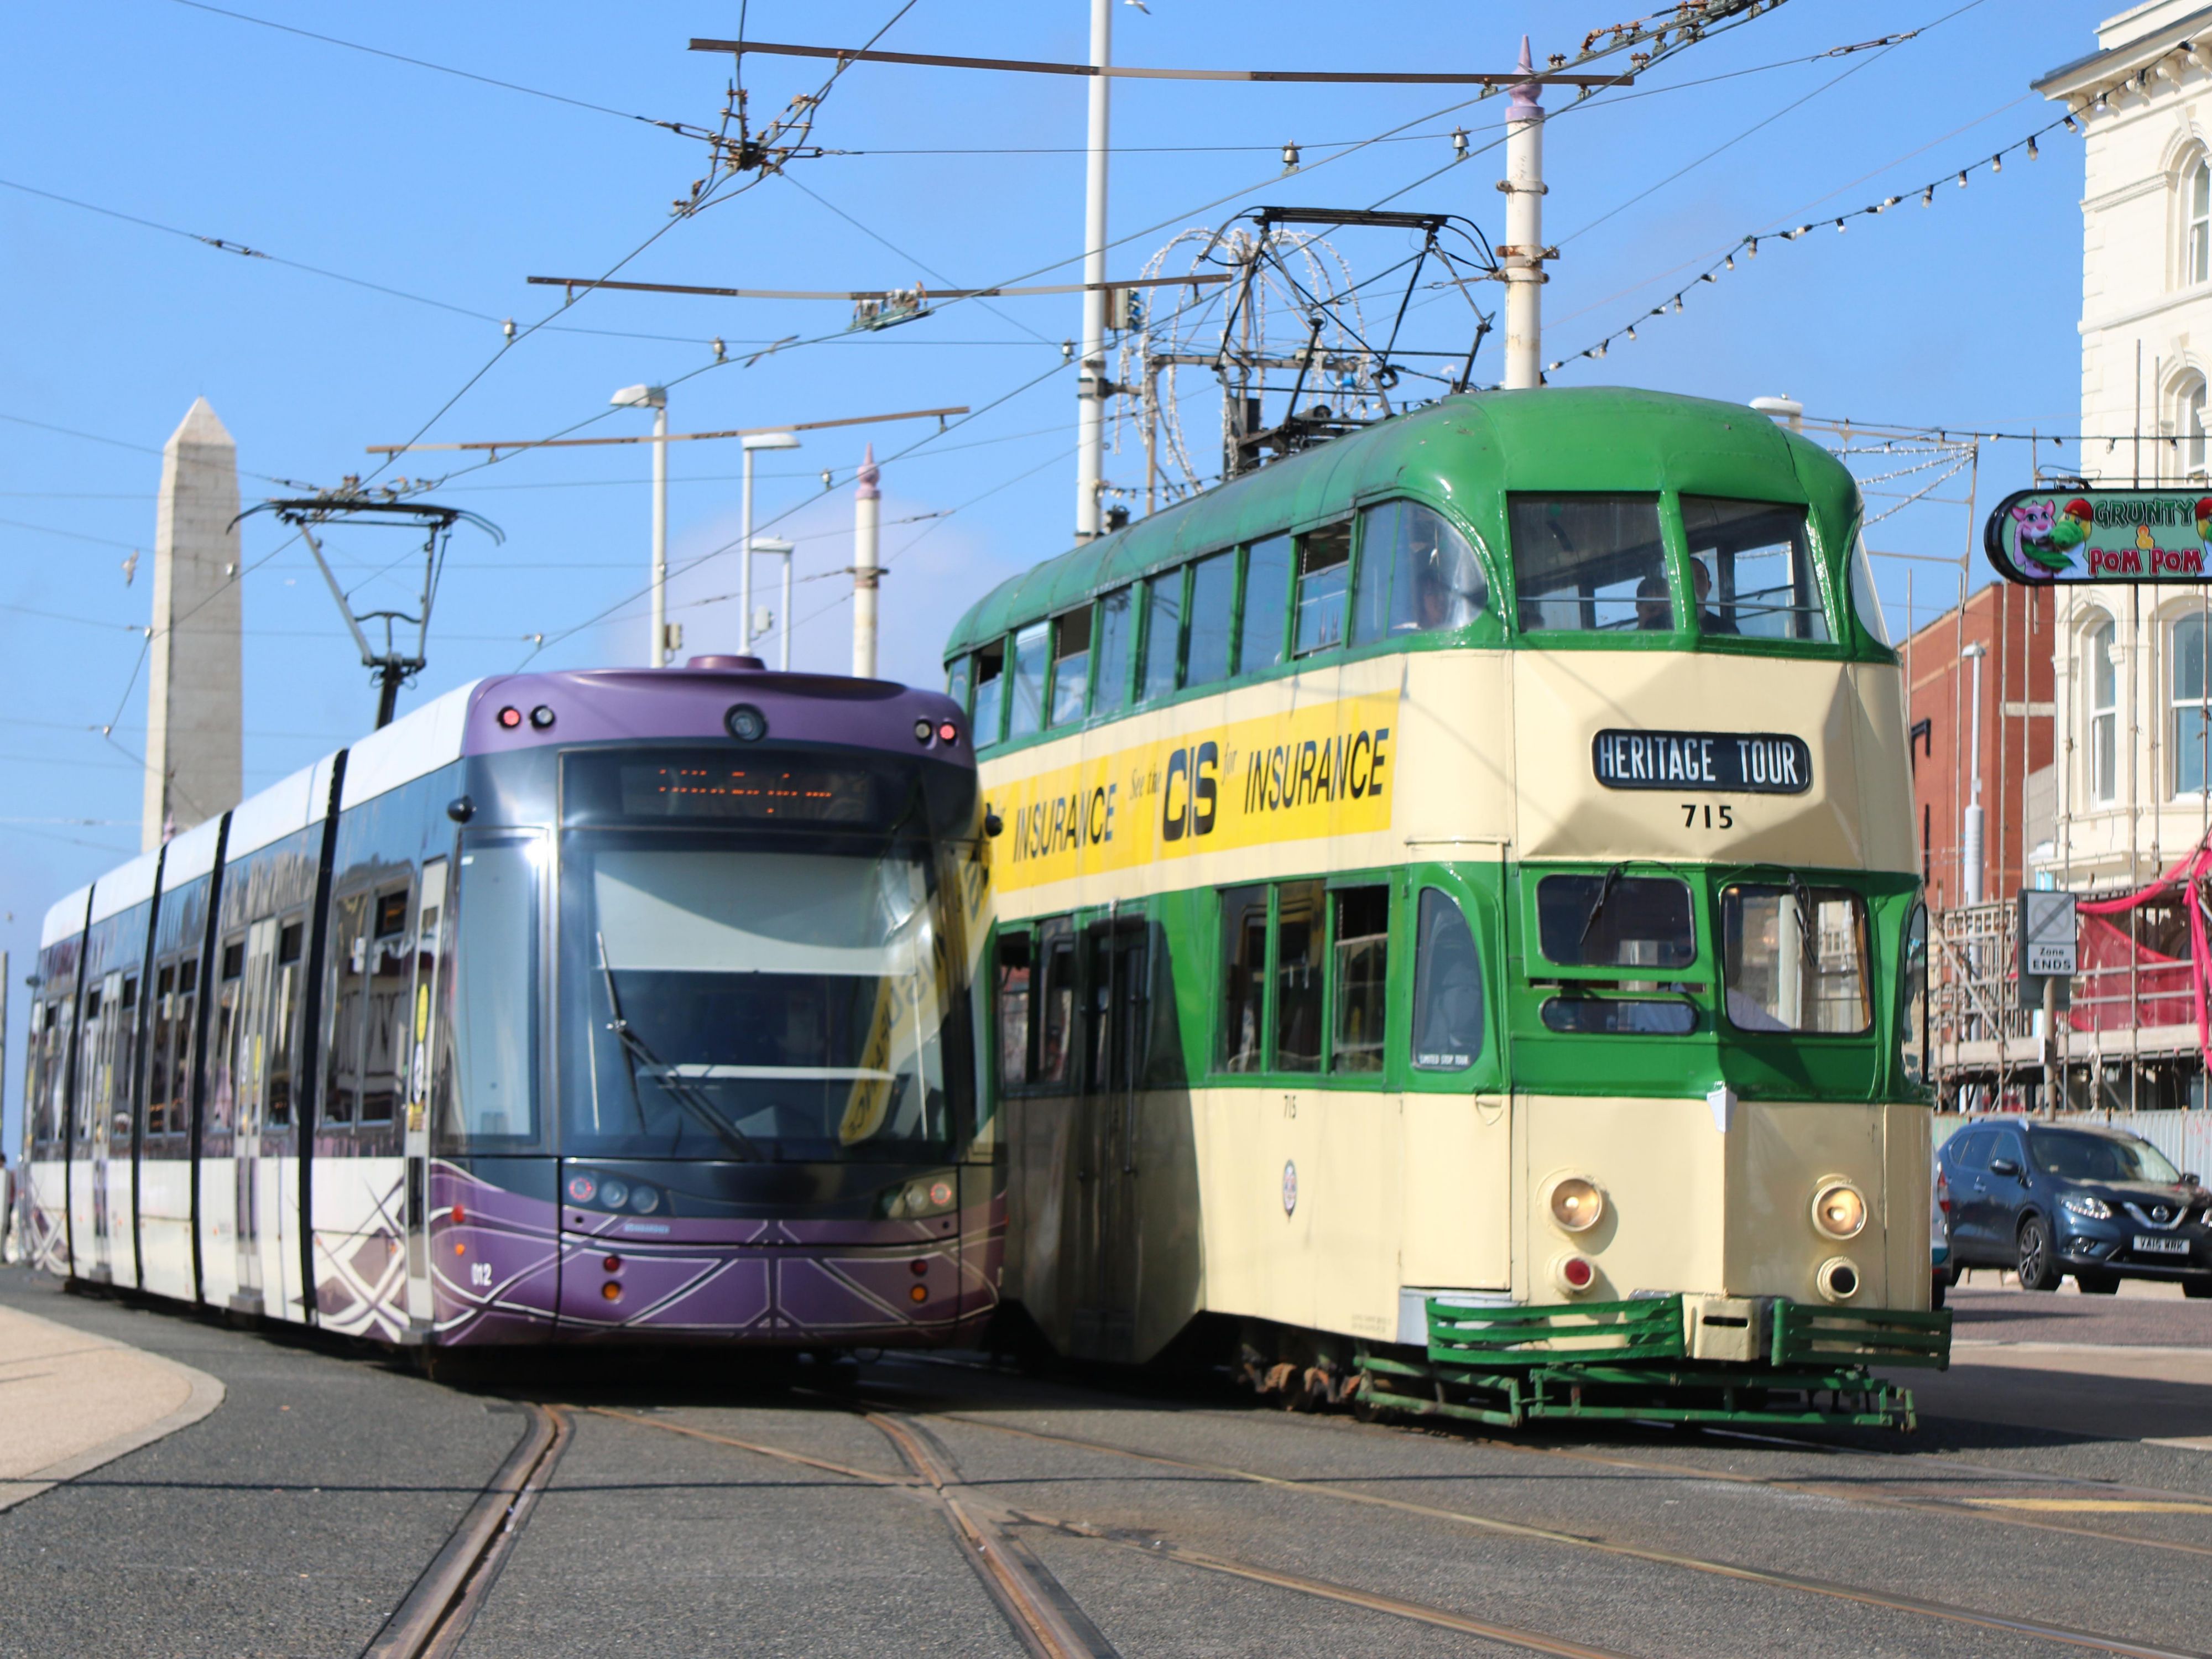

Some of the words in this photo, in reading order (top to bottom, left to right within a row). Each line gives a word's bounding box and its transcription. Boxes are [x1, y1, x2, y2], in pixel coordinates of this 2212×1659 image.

[2093, 499, 2195, 528] GRUNTY
[2136, 525, 2154, 550] &
[2089, 548, 2143, 576] POM
[2149, 548, 2204, 576] POM
[1600, 734, 1716, 782] HERITAGE
[1737, 739, 1799, 785] TOUR
[1013, 783, 1117, 863] INSURANCE
[1129, 768, 1145, 800] See
[1147, 763, 1162, 795] the
[1163, 741, 1218, 842] CIS
[1222, 742, 1238, 786] for
[1244, 728, 1390, 815] INSURANCE
[1681, 804, 1733, 830] 715
[2040, 947, 2064, 957] Zone
[2033, 959, 2072, 971] ENDS
[1284, 1095, 1297, 1119] 715
[471, 1262, 492, 1286] 012
